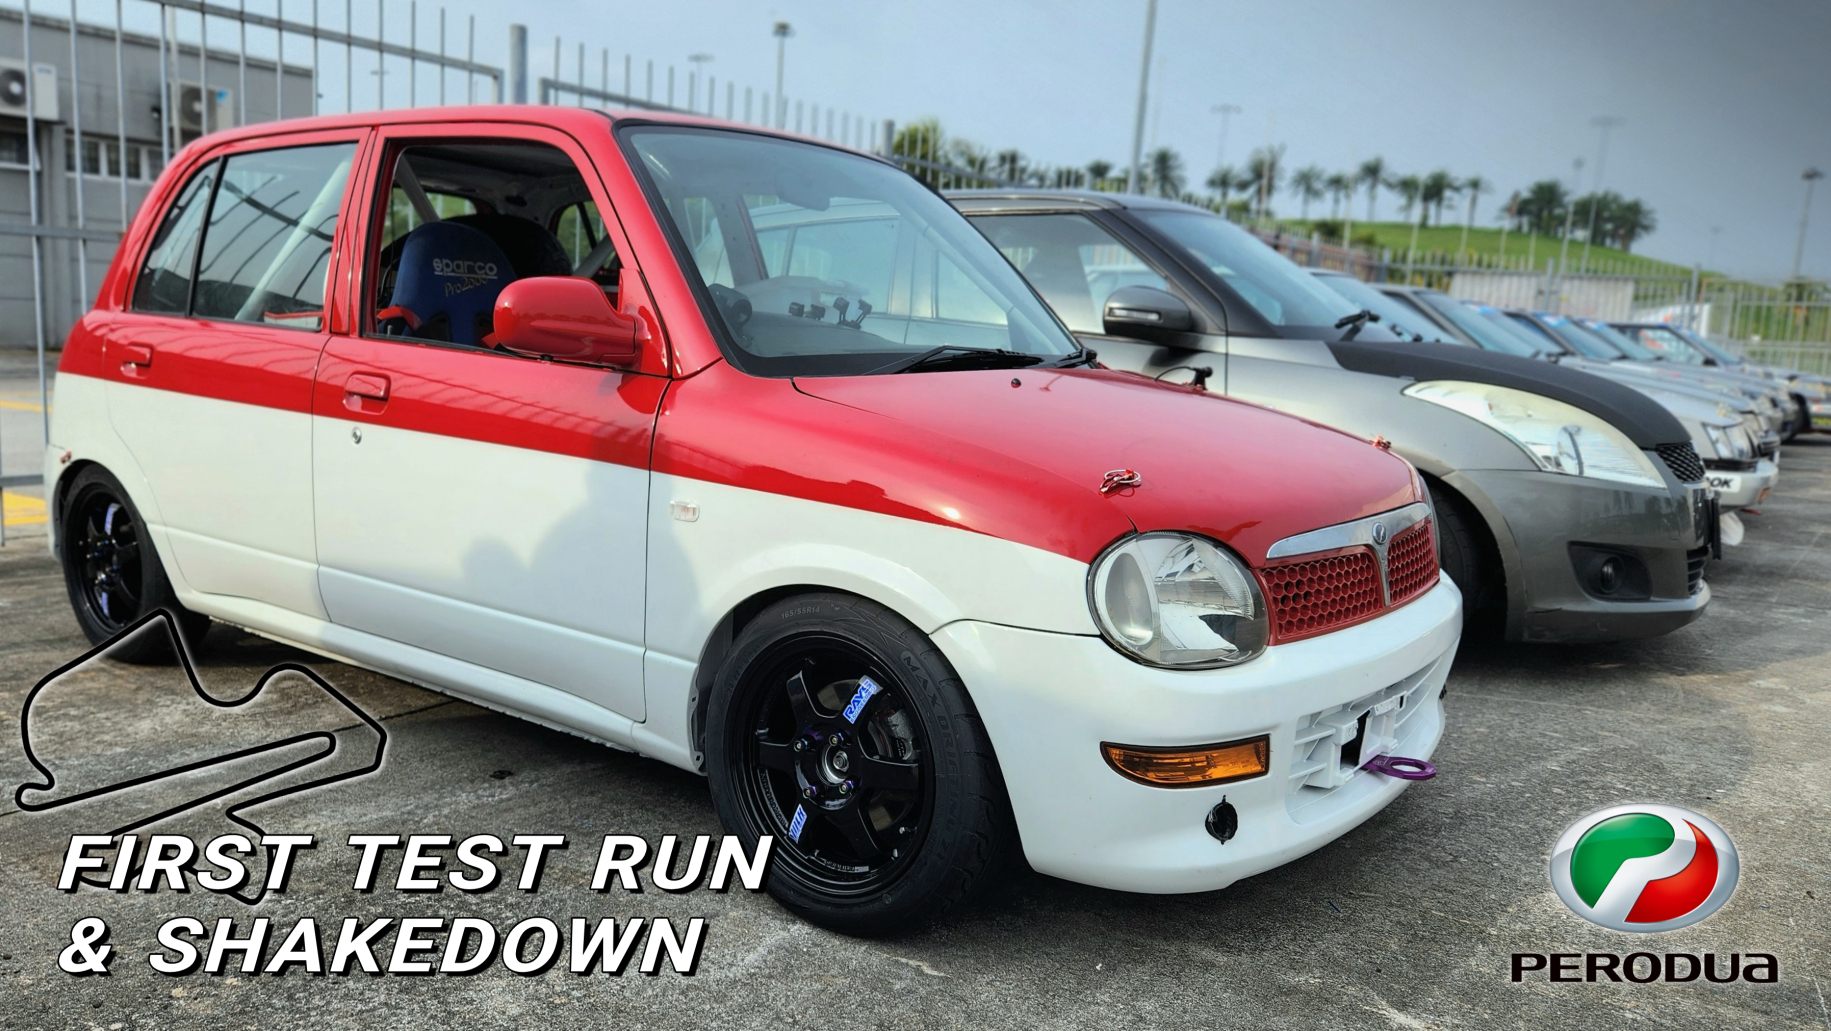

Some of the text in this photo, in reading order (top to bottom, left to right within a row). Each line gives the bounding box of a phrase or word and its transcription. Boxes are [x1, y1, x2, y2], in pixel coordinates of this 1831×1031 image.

[432, 258, 498, 276] sparco
[1704, 476, 1734, 490] OK
[781, 606, 820, 619] 165/55R14
[903, 656, 941, 708] MAX
[844, 680, 873, 719] RAYS
